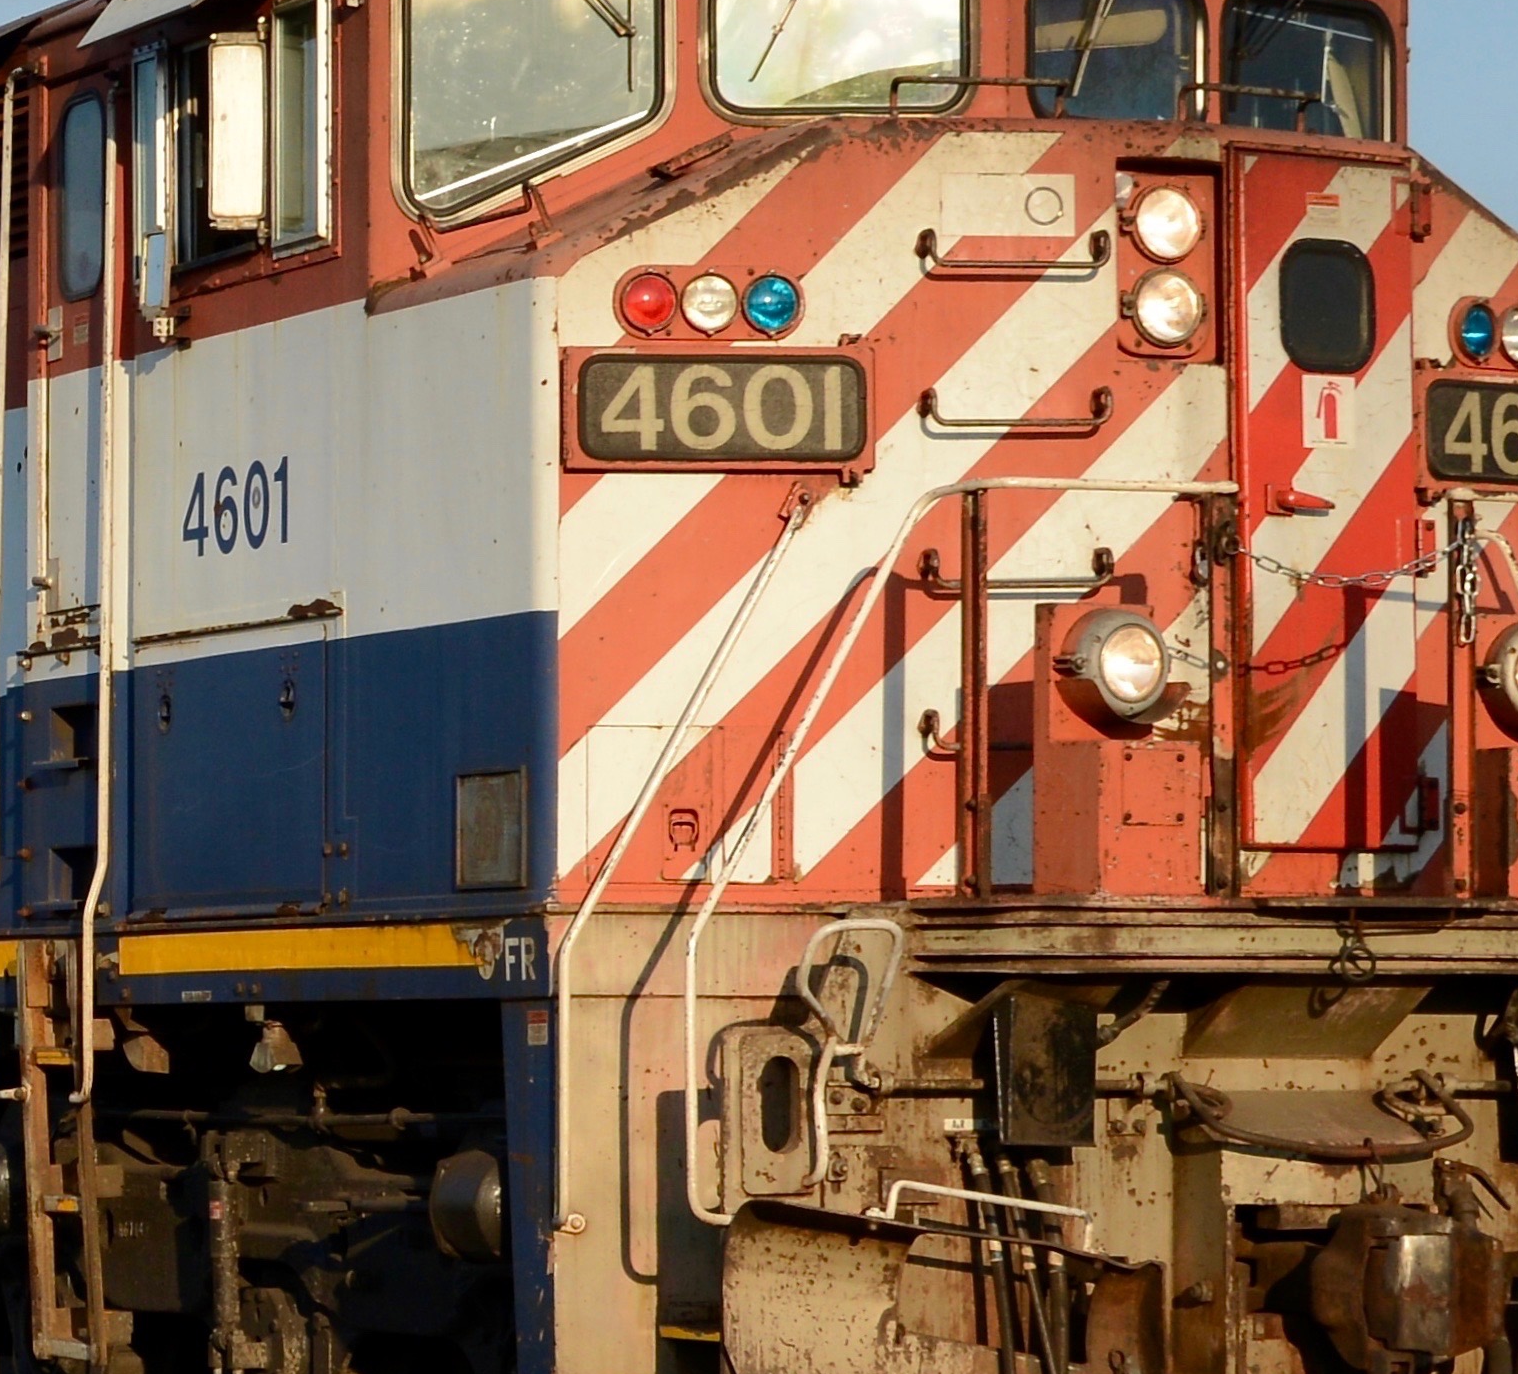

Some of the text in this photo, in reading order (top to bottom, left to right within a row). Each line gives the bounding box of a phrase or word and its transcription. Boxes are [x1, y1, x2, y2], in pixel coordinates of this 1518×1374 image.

[600, 364, 843, 451] 4601
[182, 455, 289, 557] 4601
[505, 936, 537, 982] FR
